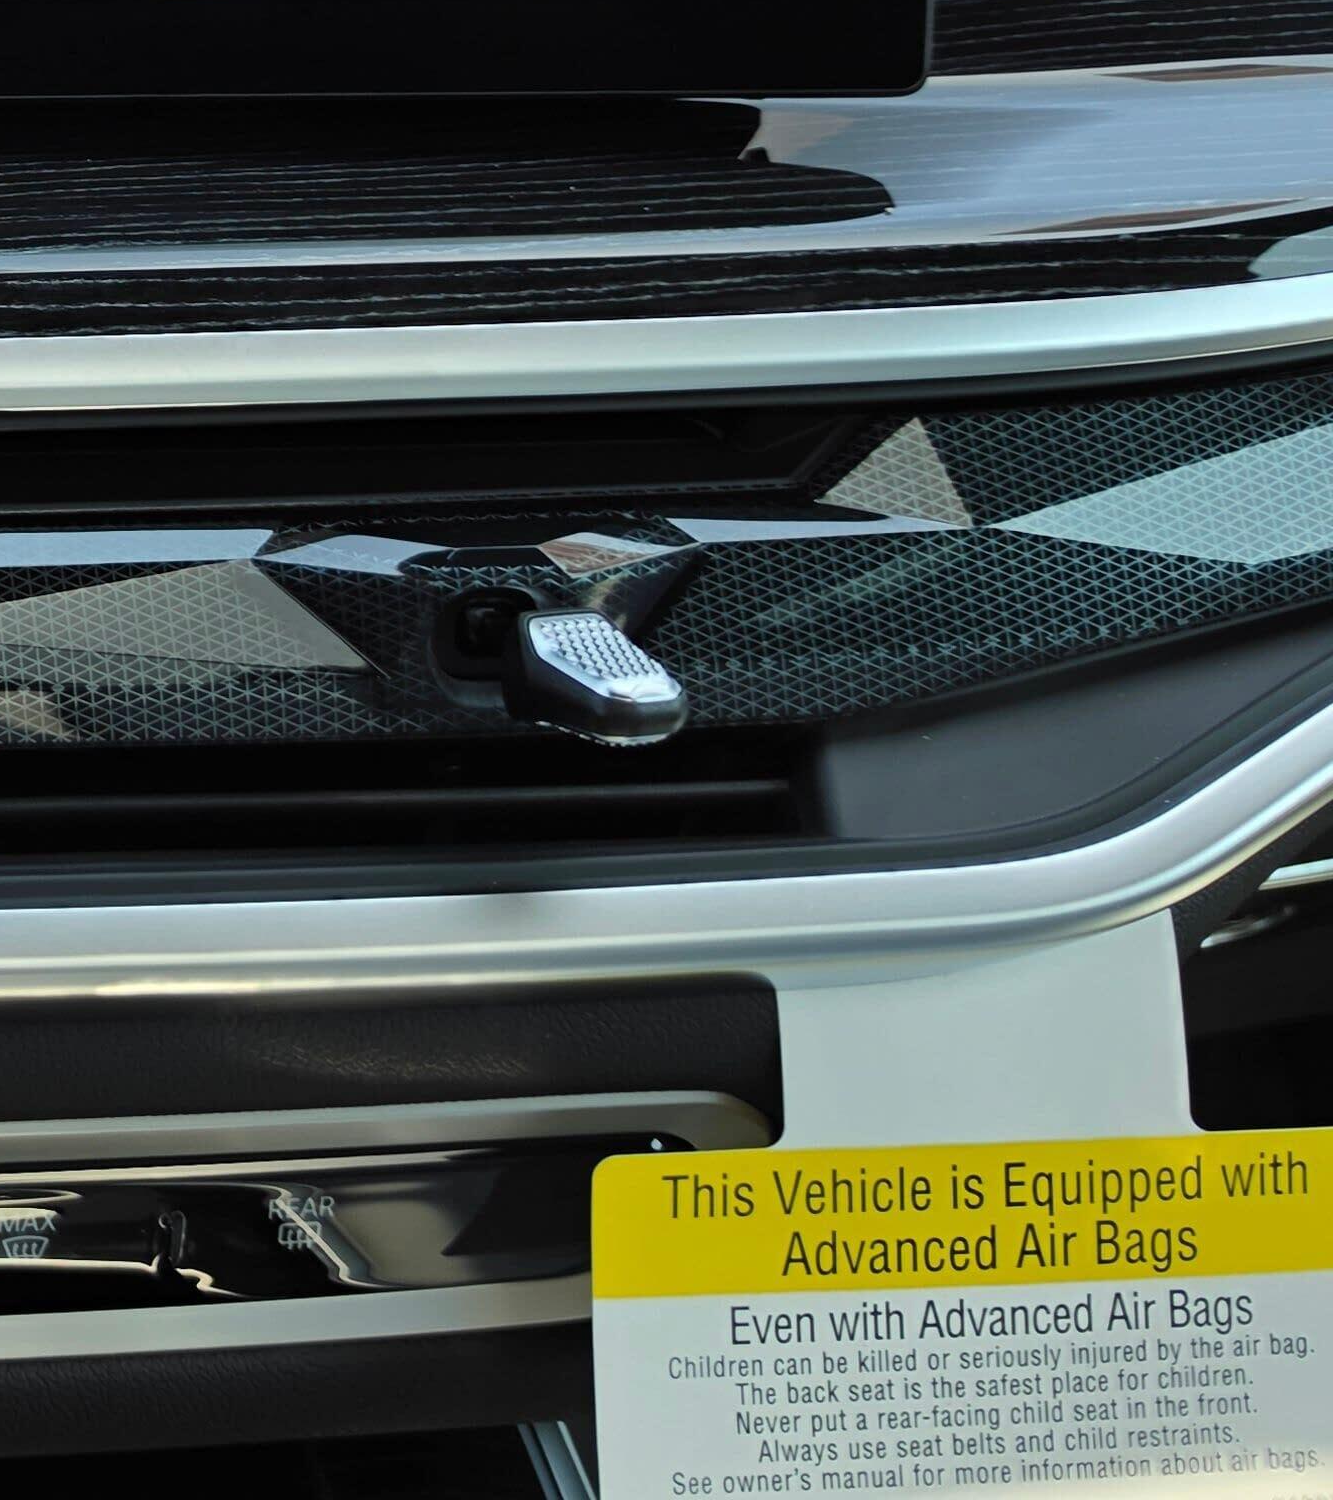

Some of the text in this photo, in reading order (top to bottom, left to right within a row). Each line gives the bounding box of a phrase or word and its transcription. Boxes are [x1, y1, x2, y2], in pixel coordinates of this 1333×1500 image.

[267, 1195, 337, 1221] REAR
[660, 1150, 1309, 1220] This Vehicle is Equipped with
[780, 1219, 1199, 1277] Advanced Air Bags
[729, 1288, 1255, 1346] Even with Advanced Air Bags
[667, 1332, 1316, 1381] Children can be killed or seriously injured by the air bag.
[734, 1363, 1255, 1406] The back seat is the safest place for children.
[735, 1391, 1259, 1438] Never put a rear-facing child seat in the front.
[758, 1422, 1241, 1467] Always use seat belts and child restraints.
[671, 1447, 1327, 1497] See owner's manual for more information about air bags.
